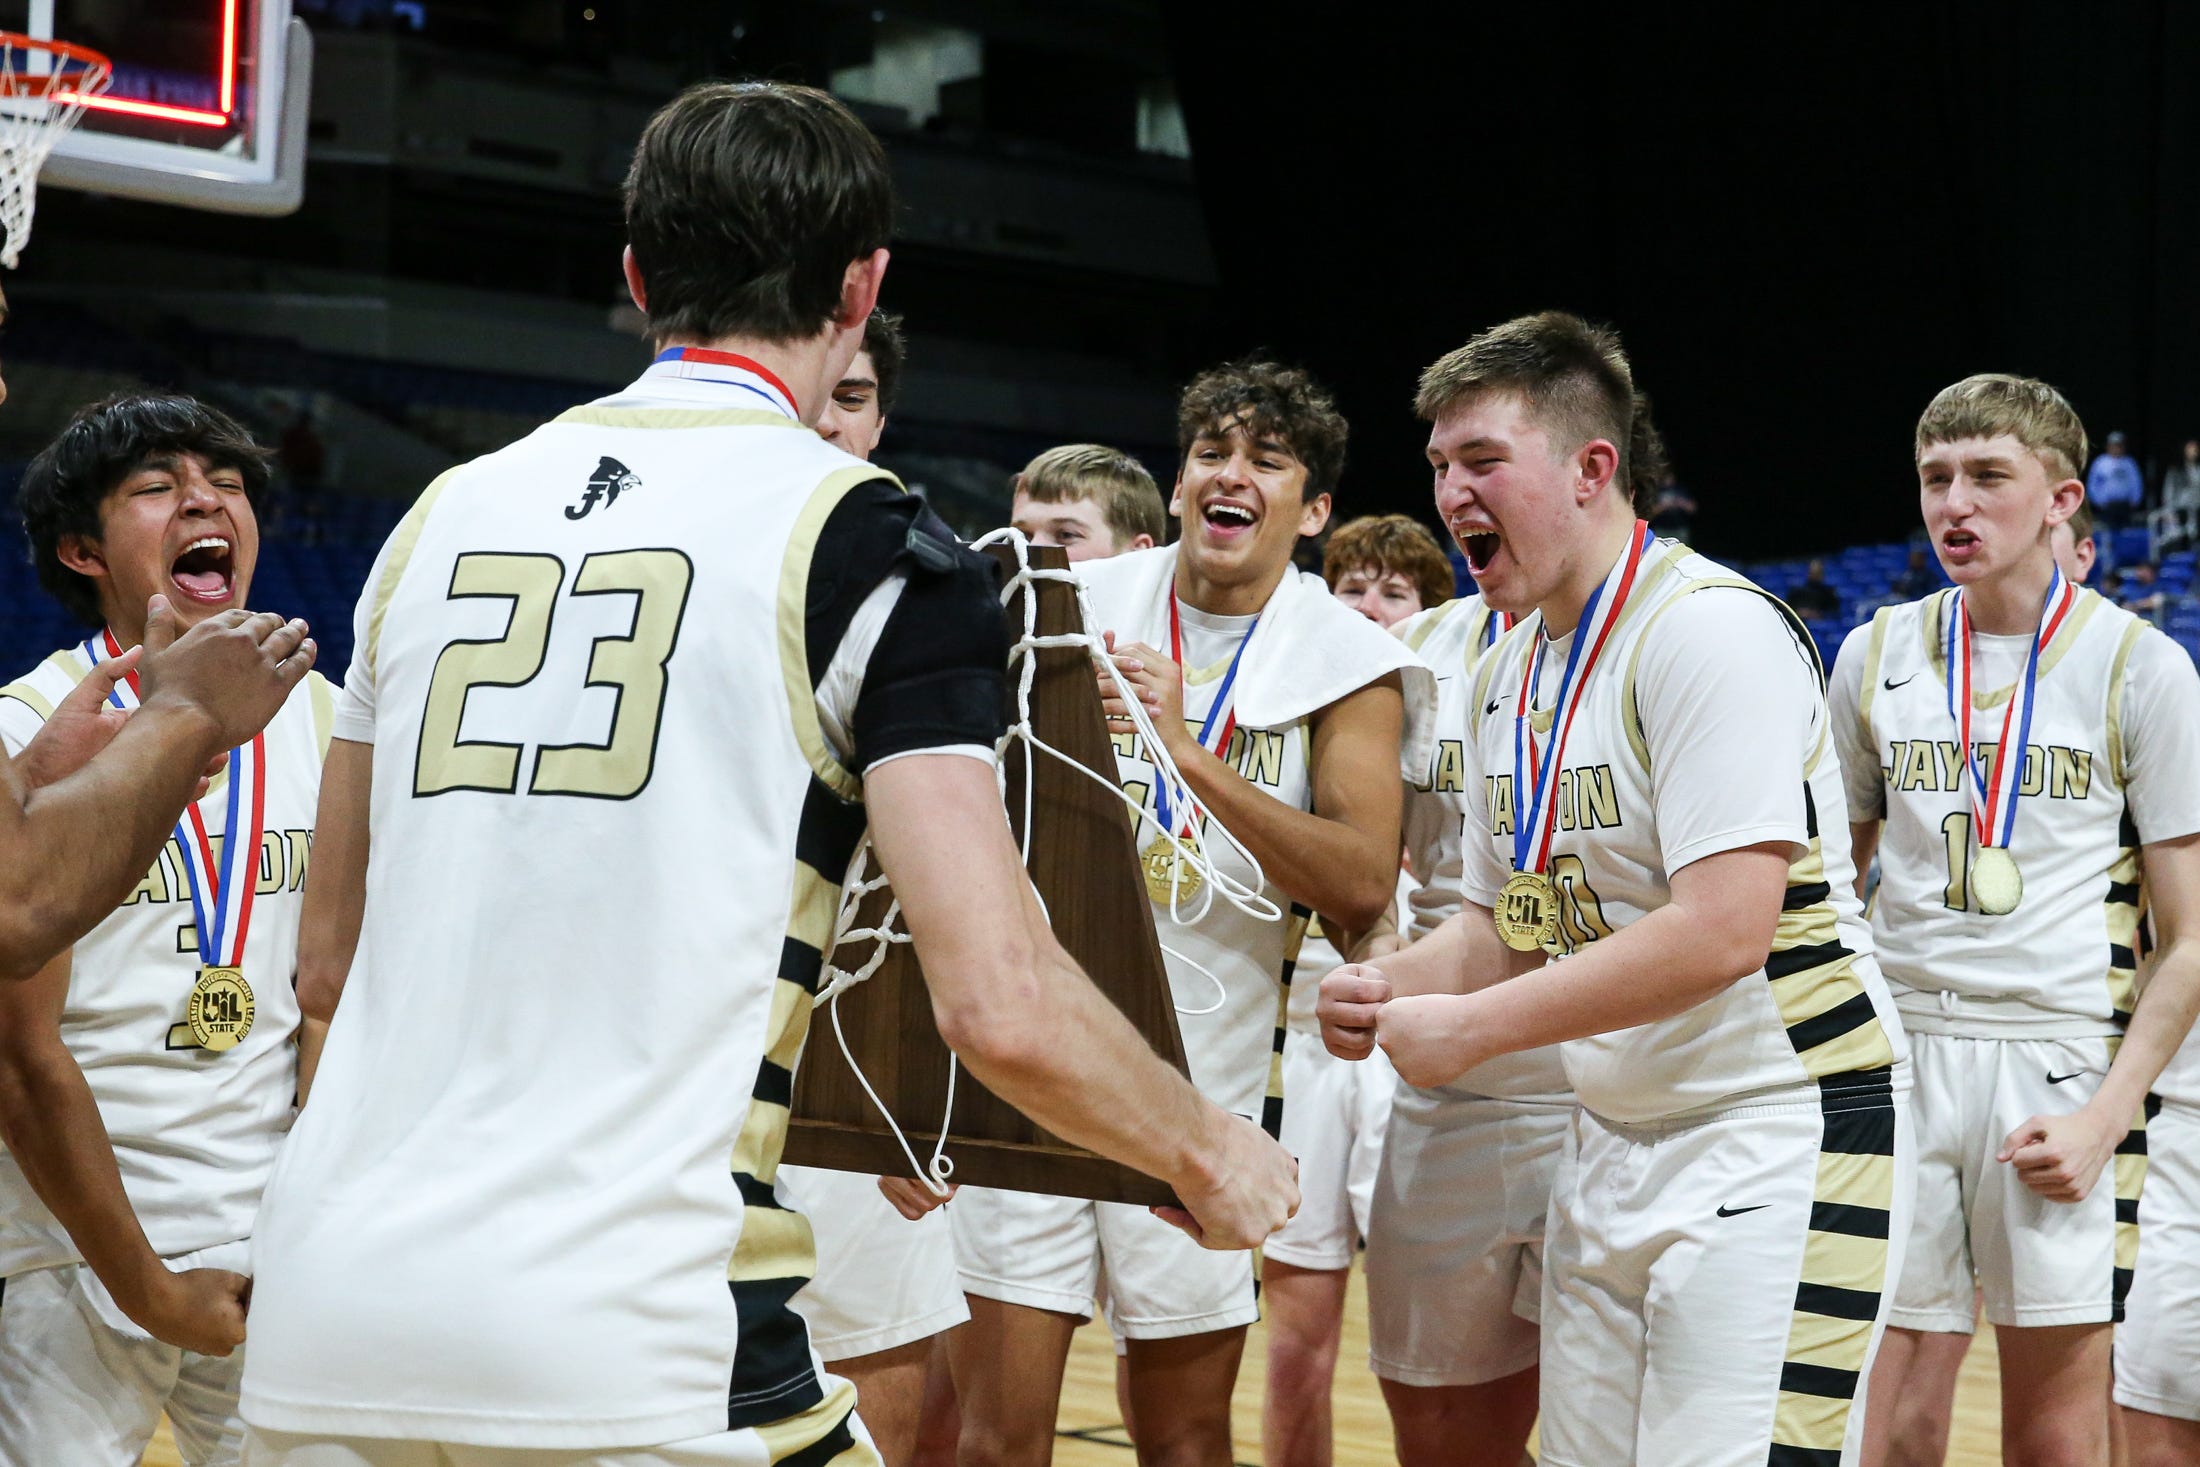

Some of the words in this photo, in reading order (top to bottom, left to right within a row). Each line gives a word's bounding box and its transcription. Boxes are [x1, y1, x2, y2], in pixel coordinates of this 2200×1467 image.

[412, 548, 694, 800] 23
[1506, 893, 1543, 926] UIL
[1511, 924, 1536, 936] STATE
[203, 987, 242, 1022] UIL
[210, 1023, 235, 1033] STATE
